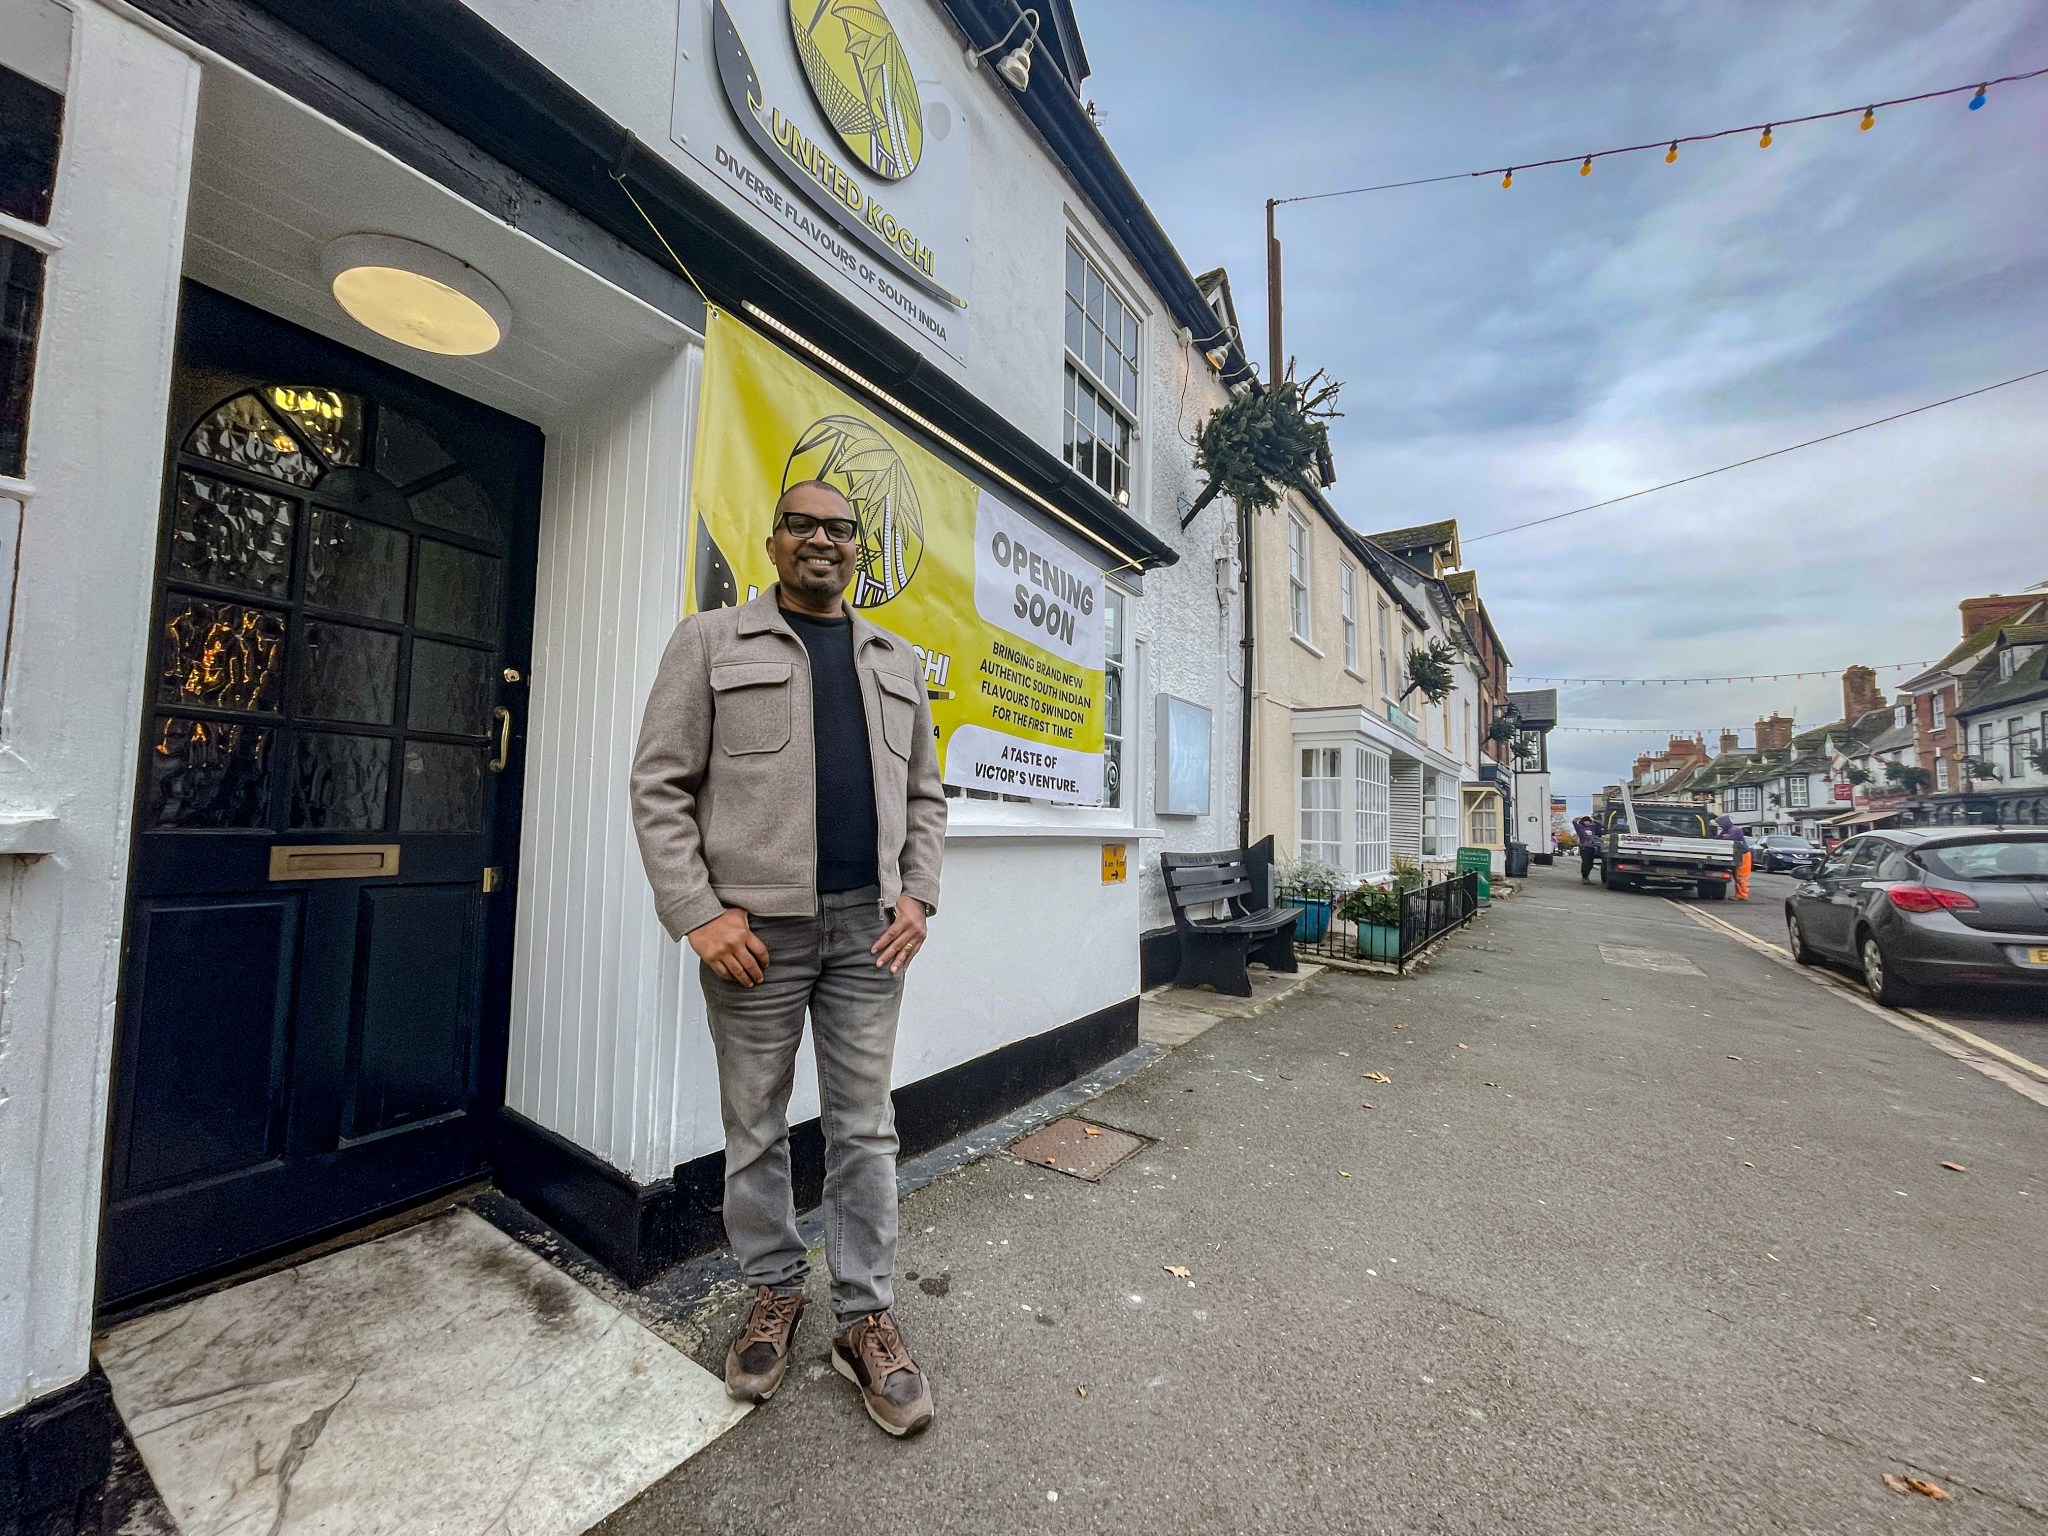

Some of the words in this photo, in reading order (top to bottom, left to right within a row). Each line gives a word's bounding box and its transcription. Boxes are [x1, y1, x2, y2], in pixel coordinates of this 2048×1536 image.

[771, 106, 864, 211] UNITED
[866, 195, 936, 277] KOCHI
[715, 144, 783, 213] DIVERSE
[784, 204, 858, 271] FLAVOURS
[859, 263, 877, 285] OF
[878, 277, 917, 320] SOUTH
[918, 309, 948, 342] INDIA
[991, 531, 1094, 617] OPENING
[1013, 583, 1075, 646] SOON
[980, 658, 1032, 690] AUTHENTIC
[1032, 680, 1059, 700] SOUTH
[1058, 689, 1092, 710] INDIAN
[992, 641, 1035, 671] BRINGING
[1035, 661, 1063, 684] BRAND
[1062, 673, 1084, 690] NEW
[981, 680, 1030, 708] FLAVOURS
[1029, 697, 1041, 712] TO
[1040, 704, 1085, 725] SWINDON
[992, 705, 1011, 723] FOR
[1012, 711, 1028, 728] THE
[1027, 715, 1051, 733] FIRST
[1051, 723, 1074, 740] TIME
[974, 761, 1027, 786] VICTOR'S
[1027, 773, 1080, 794] VENTURE.
[1001, 745, 1010, 760] A
[1009, 747, 1043, 768] TASTE
[1044, 753, 1059, 770] OF
